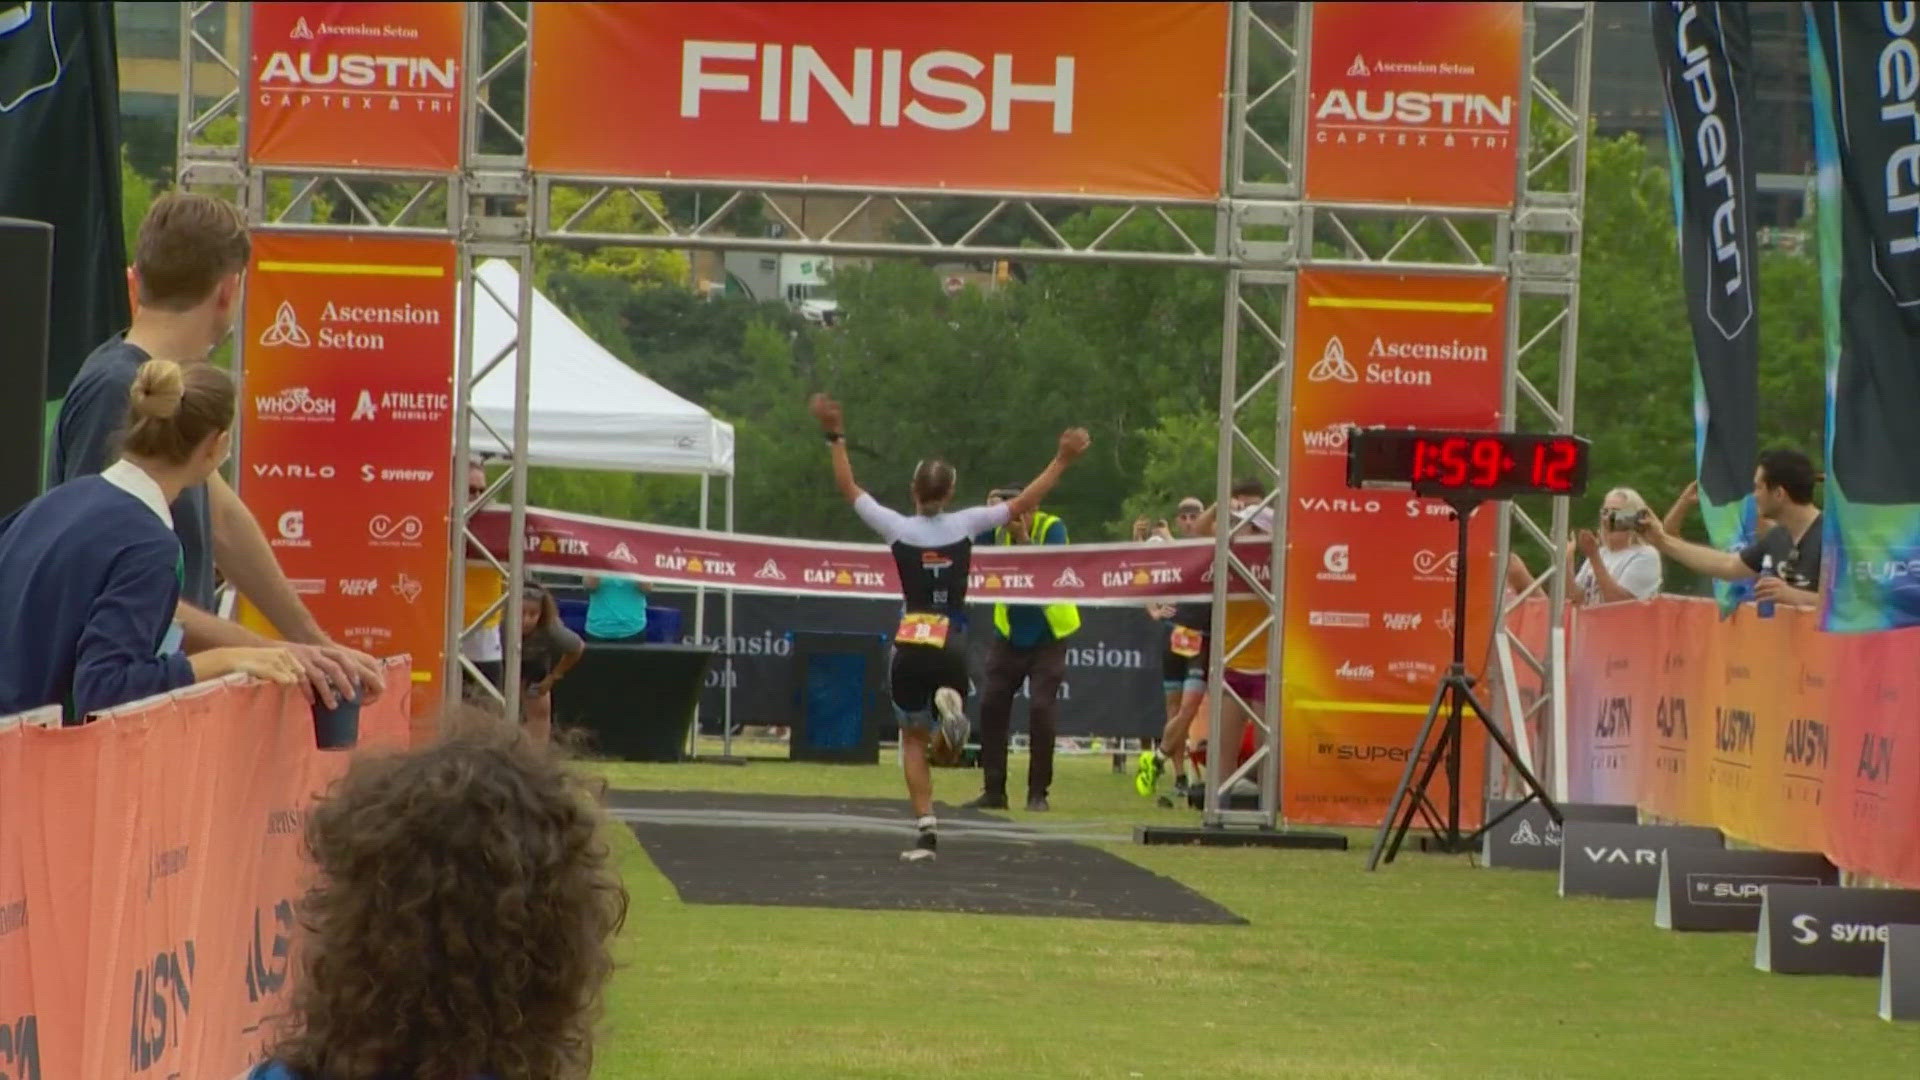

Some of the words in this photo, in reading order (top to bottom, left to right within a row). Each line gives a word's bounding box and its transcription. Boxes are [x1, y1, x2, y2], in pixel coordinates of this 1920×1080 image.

[317, 22, 381, 37] Ascension
[383, 25, 418, 38] Seton
[259, 51, 455, 88] AUSTIN
[1374, 60, 1437, 74] Ascension
[1439, 63, 1475, 75] Seton
[680, 40, 1075, 133] FINISH
[260, 94, 371, 110] CAPTEX
[417, 100, 452, 112] TRI
[1315, 89, 1511, 125] AUSTIN
[1316, 132, 1426, 147] CAPTEX
[1472, 136, 1507, 149] TRI
[320, 301, 440, 325] Ascension
[318, 327, 384, 350] Seton
[1369, 336, 1488, 362] Ascension
[1366, 364, 1431, 386] Seton
[256, 396, 336, 414] WHOOSH
[381, 392, 448, 410] ATHLETIC
[253, 464, 335, 478] VARLO
[381, 468, 434, 481] synergy
[1299, 498, 1380, 513] VARLO
[655, 553, 686, 572] CAP
[703, 558, 736, 576] TEX
[803, 568, 836, 584] CAP
[854, 571, 885, 587] TEX
[1102, 570, 1133, 587] CAP
[1318, 743, 1333, 754] BY
